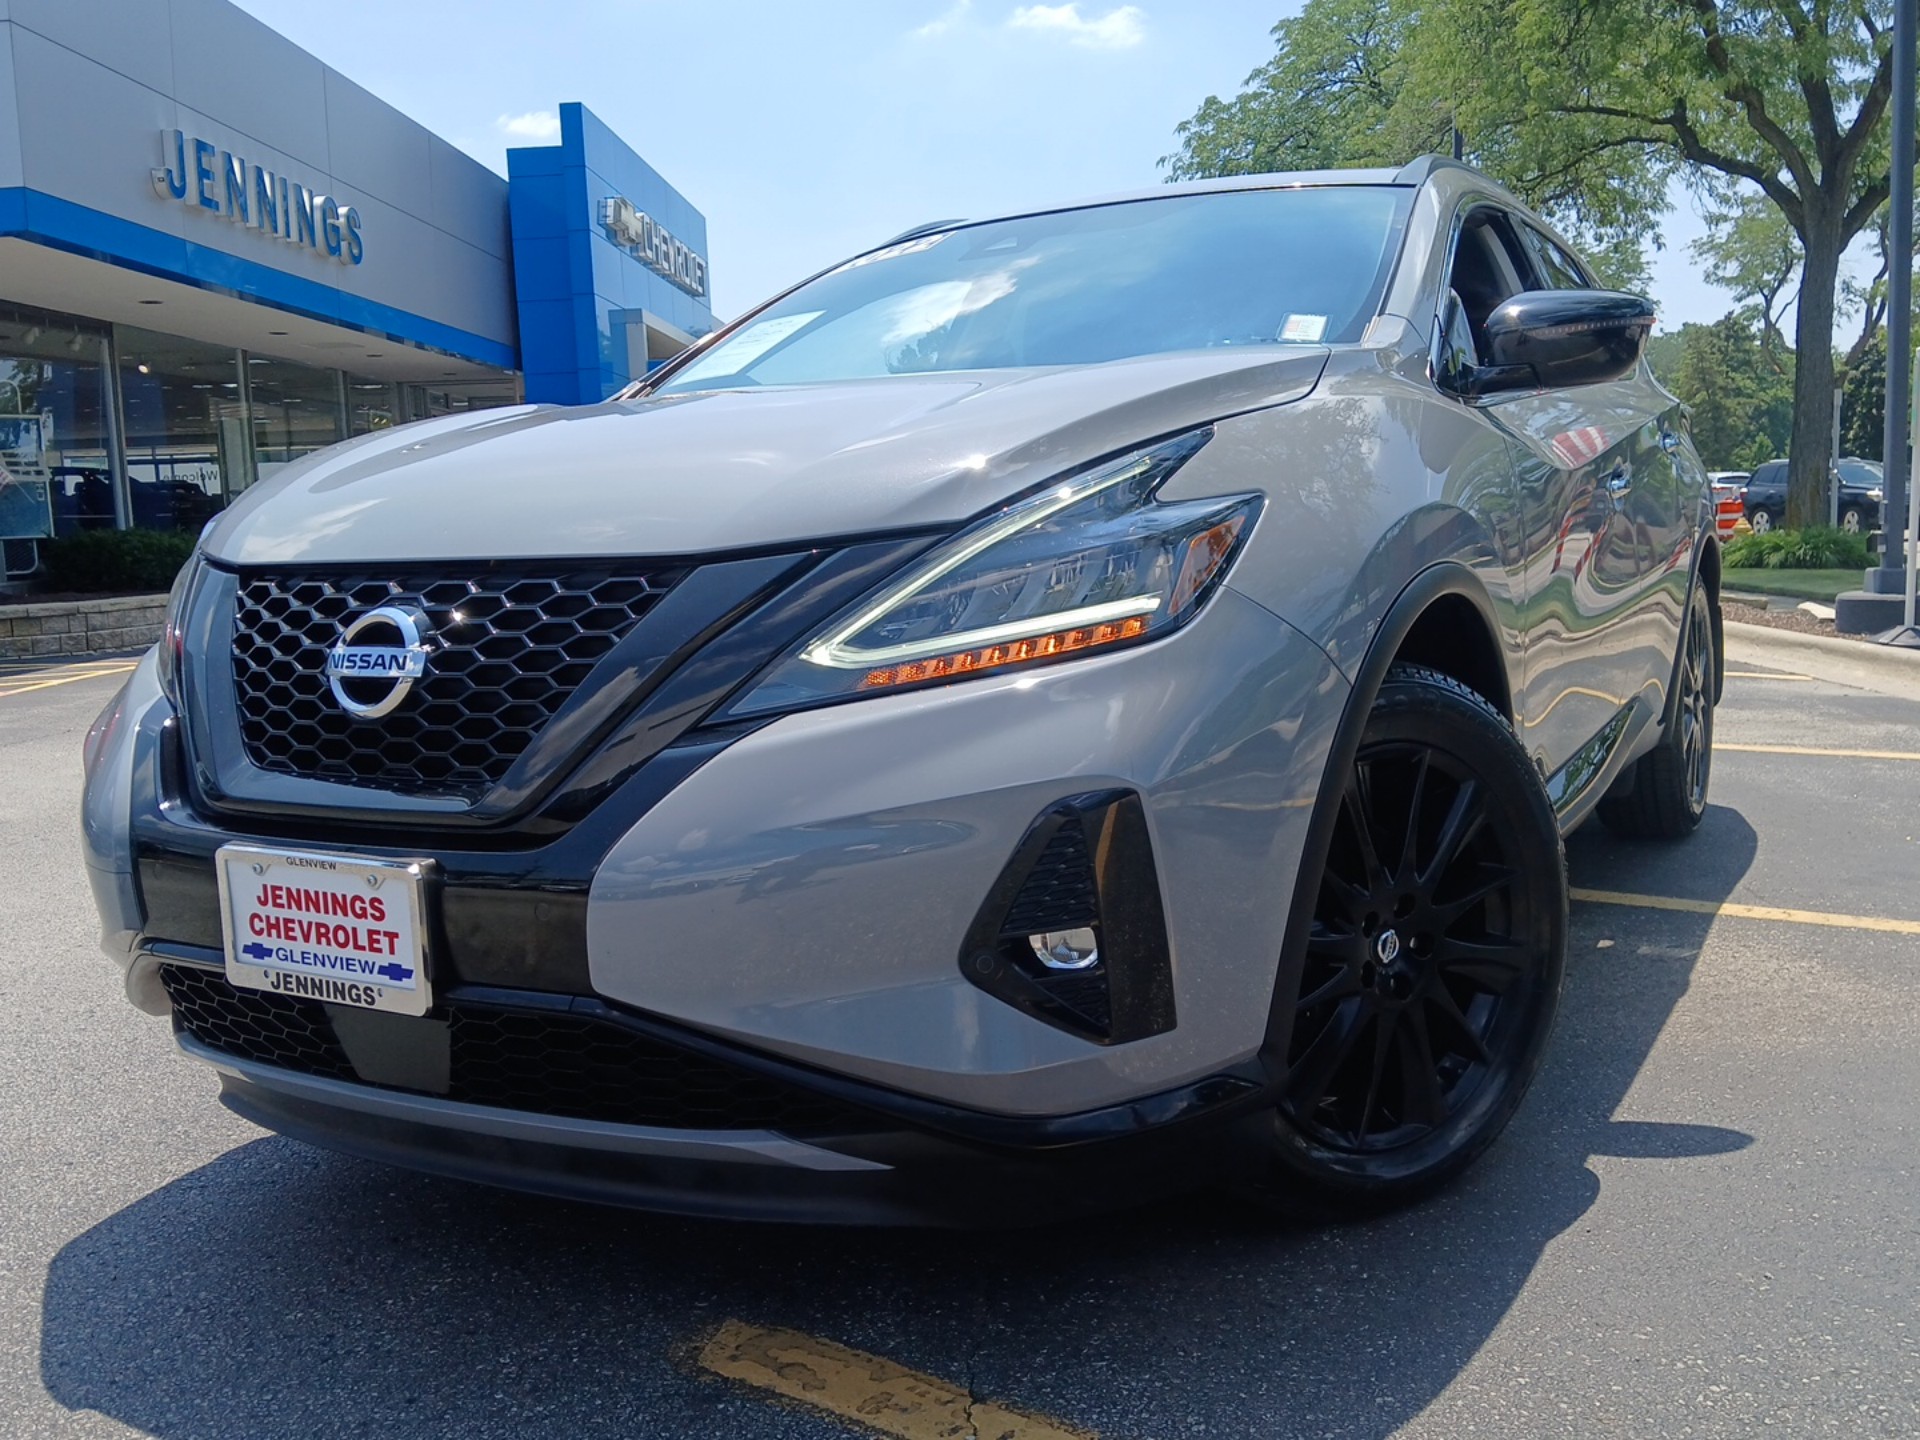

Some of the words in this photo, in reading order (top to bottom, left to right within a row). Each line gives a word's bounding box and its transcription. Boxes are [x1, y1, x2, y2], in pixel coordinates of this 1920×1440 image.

[151, 129, 363, 265] JENNINGS
[329, 653, 408, 671] NISSAN
[286, 856, 337, 871] GLENVIEW
[256, 884, 386, 922] JENNINGS
[249, 912, 399, 955] CHEVROLET
[275, 947, 376, 975] GLENVIEW
[270, 971, 376, 1006] JENNINGS
